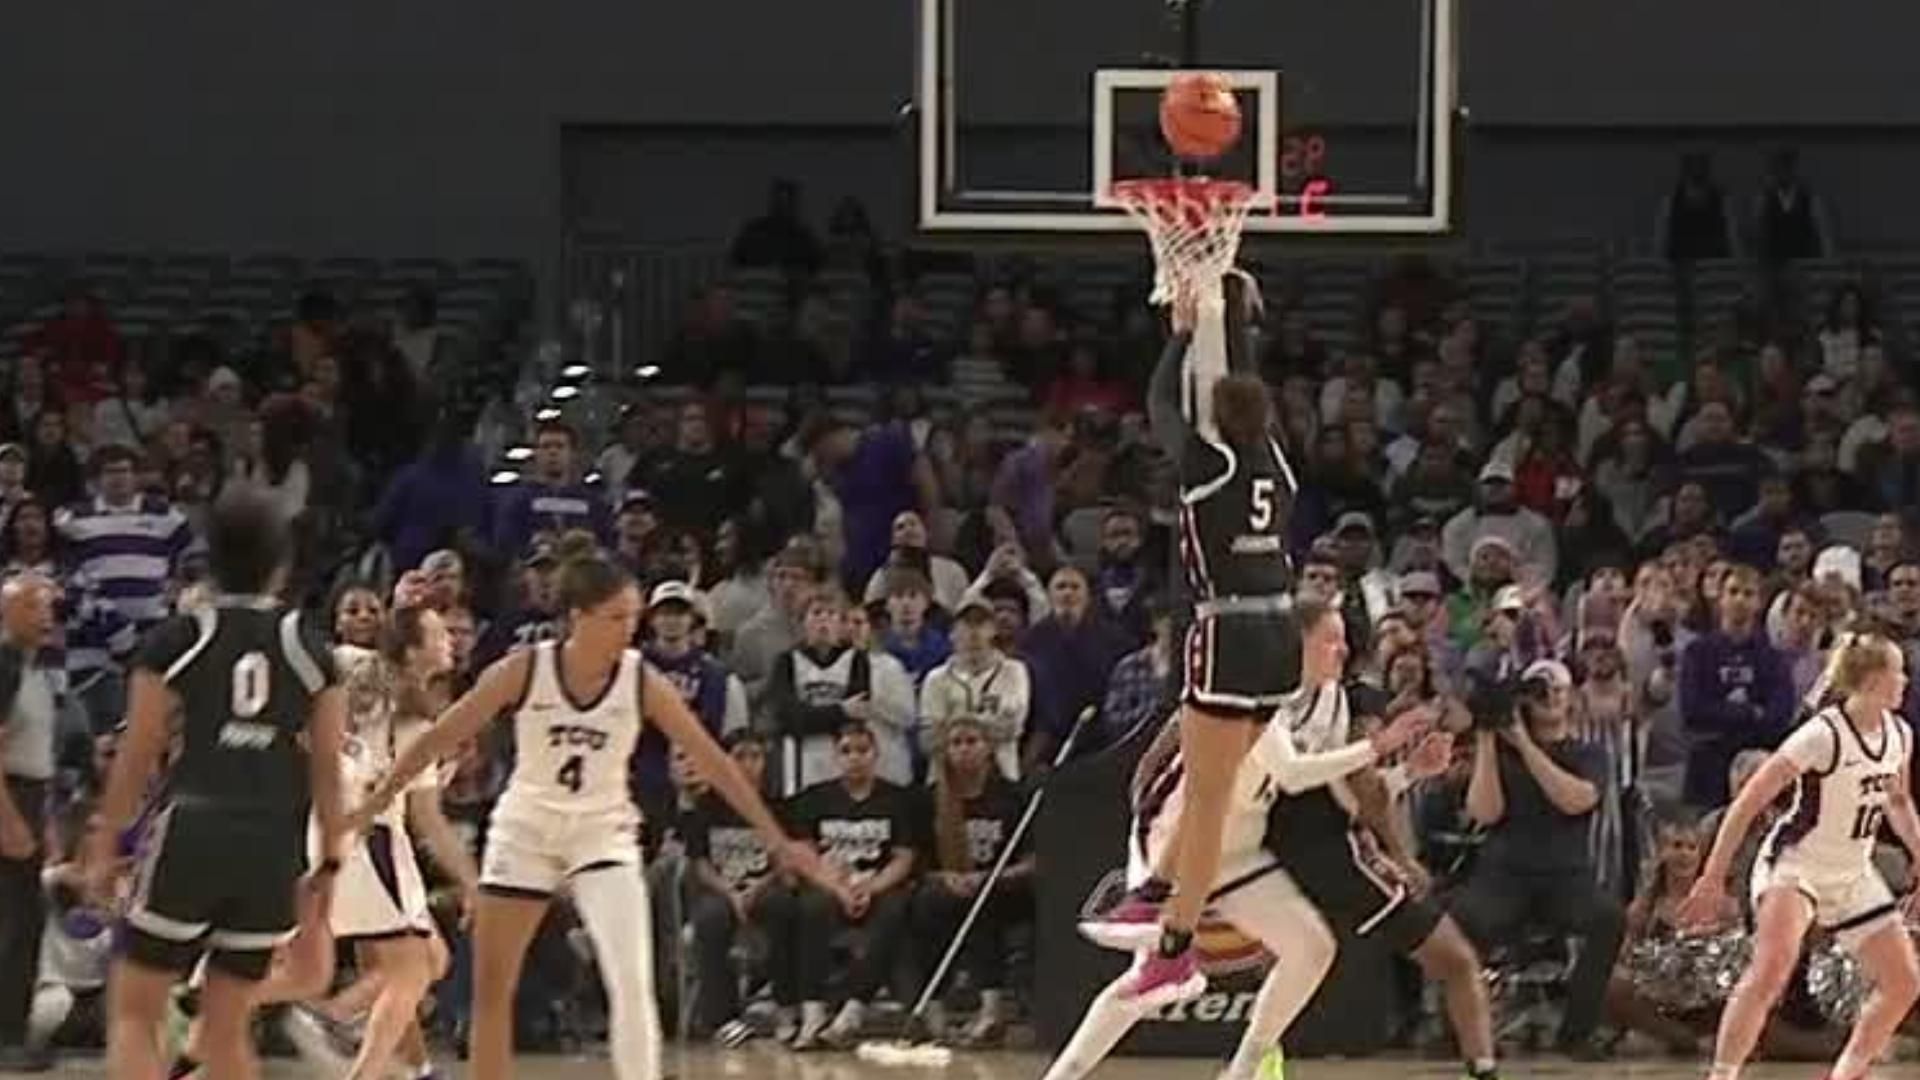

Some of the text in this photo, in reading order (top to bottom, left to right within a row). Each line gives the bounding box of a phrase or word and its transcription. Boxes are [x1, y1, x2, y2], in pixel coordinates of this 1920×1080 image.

[1250, 479, 1274, 531] 5
[232, 651, 269, 718] 0
[549, 725, 608, 751] TCU
[557, 755, 583, 793] 4
